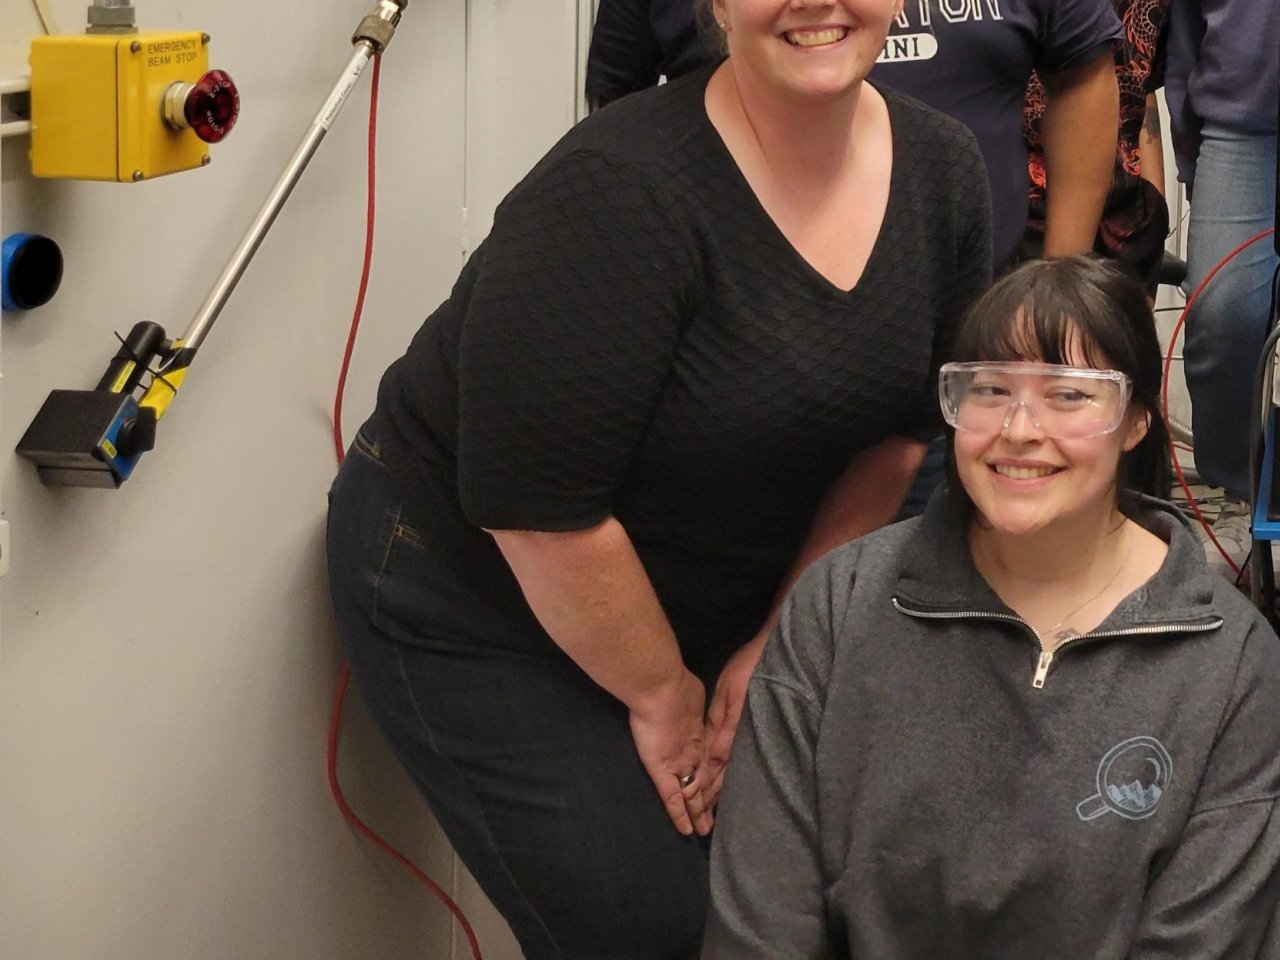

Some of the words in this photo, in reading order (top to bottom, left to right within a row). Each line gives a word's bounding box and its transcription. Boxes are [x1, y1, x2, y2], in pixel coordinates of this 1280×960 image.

[148, 40, 197, 55] EMERGENCY
[148, 56, 171, 67] BEAM
[176, 52, 198, 64] STOP
